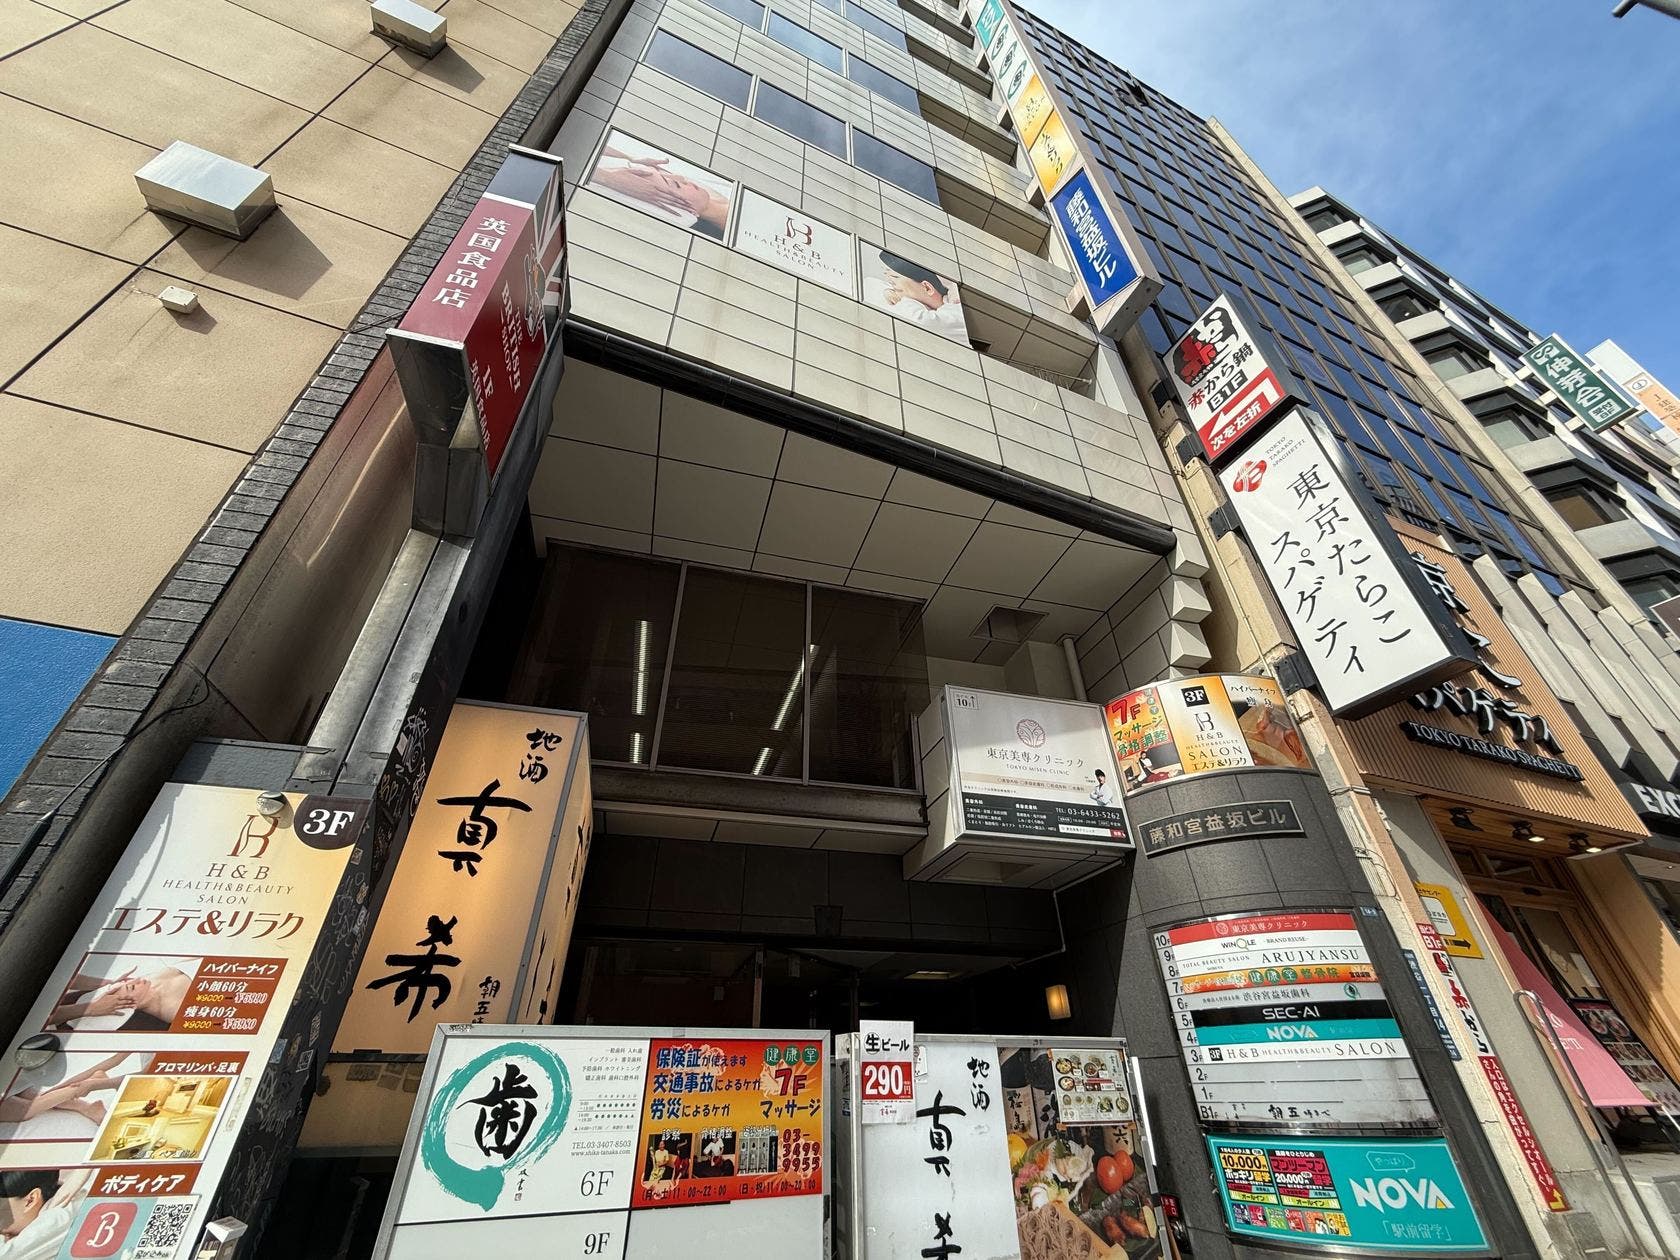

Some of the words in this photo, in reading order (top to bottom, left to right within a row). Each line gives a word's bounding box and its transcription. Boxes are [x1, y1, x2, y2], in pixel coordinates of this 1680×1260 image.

[432, 217, 511, 310] 英国食品店
[502, 280, 521, 393] BRITISH
[502, 326, 511, 372] SHOP
[1188, 342, 1254, 410] 赤から鍋
[1210, 372, 1247, 410] B1F
[1211, 401, 1262, 451] 次を左折
[1286, 463, 1411, 644] 東京たらこ
[1270, 531, 1364, 674] スパゲティ
[1184, 688, 1206, 703] 3F
[1112, 699, 1141, 725] 7F
[1114, 715, 1163, 741] マッサージ
[1117, 730, 1168, 756] 骨格調整
[1188, 745, 1243, 761] SALON
[1409, 722, 1461, 747] TOKYO
[1460, 734, 1518, 761] TARAKO
[1518, 751, 1581, 781] SPAGHETTI
[519, 728, 563, 785] 地酒
[986, 748, 1084, 768] 東京美専クリニック
[1192, 757, 1248, 772] エステ&リラク
[303, 808, 356, 837] 3F
[1067, 808, 1120, 820] 03-6433-5262
[1149, 808, 1287, 846] 藤和宮益坂ビル
[206, 862, 229, 877] H
[231, 864, 249, 879] &
[254, 865, 272, 880] B
[163, 879, 294, 895] HEALTH&BEAUTY
[197, 894, 249, 905] SALON
[102, 906, 305, 940] エステ&リラク
[1156, 935, 1170, 946] 10F
[1423, 935, 1442, 949] B1F
[1163, 951, 1175, 962] 9F
[1168, 966, 1179, 977] 8F
[1261, 949, 1360, 965] ARUJYANSU
[197, 980, 248, 993] 小顔60分
[1172, 982, 1183, 994] 7F
[1177, 998, 1188, 1010] 6F
[1243, 988, 1310, 1002] 渋谷宮益坂歯科
[184, 1005, 238, 1018] 痩身60分
[1182, 1014, 1193, 1027] 5F
[1263, 1006, 1321, 1020] SEC-AI
[865, 1033, 910, 1054] 生ビール
[1186, 1032, 1198, 1044] 4F
[1265, 1024, 1319, 1042] NOVA
[656, 1047, 748, 1069] 保険証が使えます
[765, 1045, 820, 1066] 健康堂
[1191, 1049, 1203, 1063] 3F
[1209, 1048, 1223, 1060] 3F
[1227, 1048, 1237, 1059] H
[1239, 1047, 1248, 1058] &
[1251, 1047, 1259, 1057] B
[1335, 1042, 1398, 1057] SALON
[653, 1072, 761, 1094] 交通事故によるケガ
[775, 1068, 808, 1097] 7F
[967, 1057, 990, 1111] 地酒
[1196, 1067, 1208, 1081] 2F
[1201, 1086, 1213, 1100] 1F
[456, 1063, 539, 1160] 歯
[650, 1097, 730, 1120] 労災によるケガ
[760, 1098, 821, 1119] マッサージ
[1200, 1105, 1218, 1119] B1F
[782, 1157, 821, 1172] 9955
[1271, 1158, 1326, 1172] マンツーマン
[101, 1174, 186, 1194] ボディケア
[580, 1170, 614, 1197] 6F
[1349, 1177, 1455, 1213] NOVA
[584, 1232, 610, 1255] 9F
